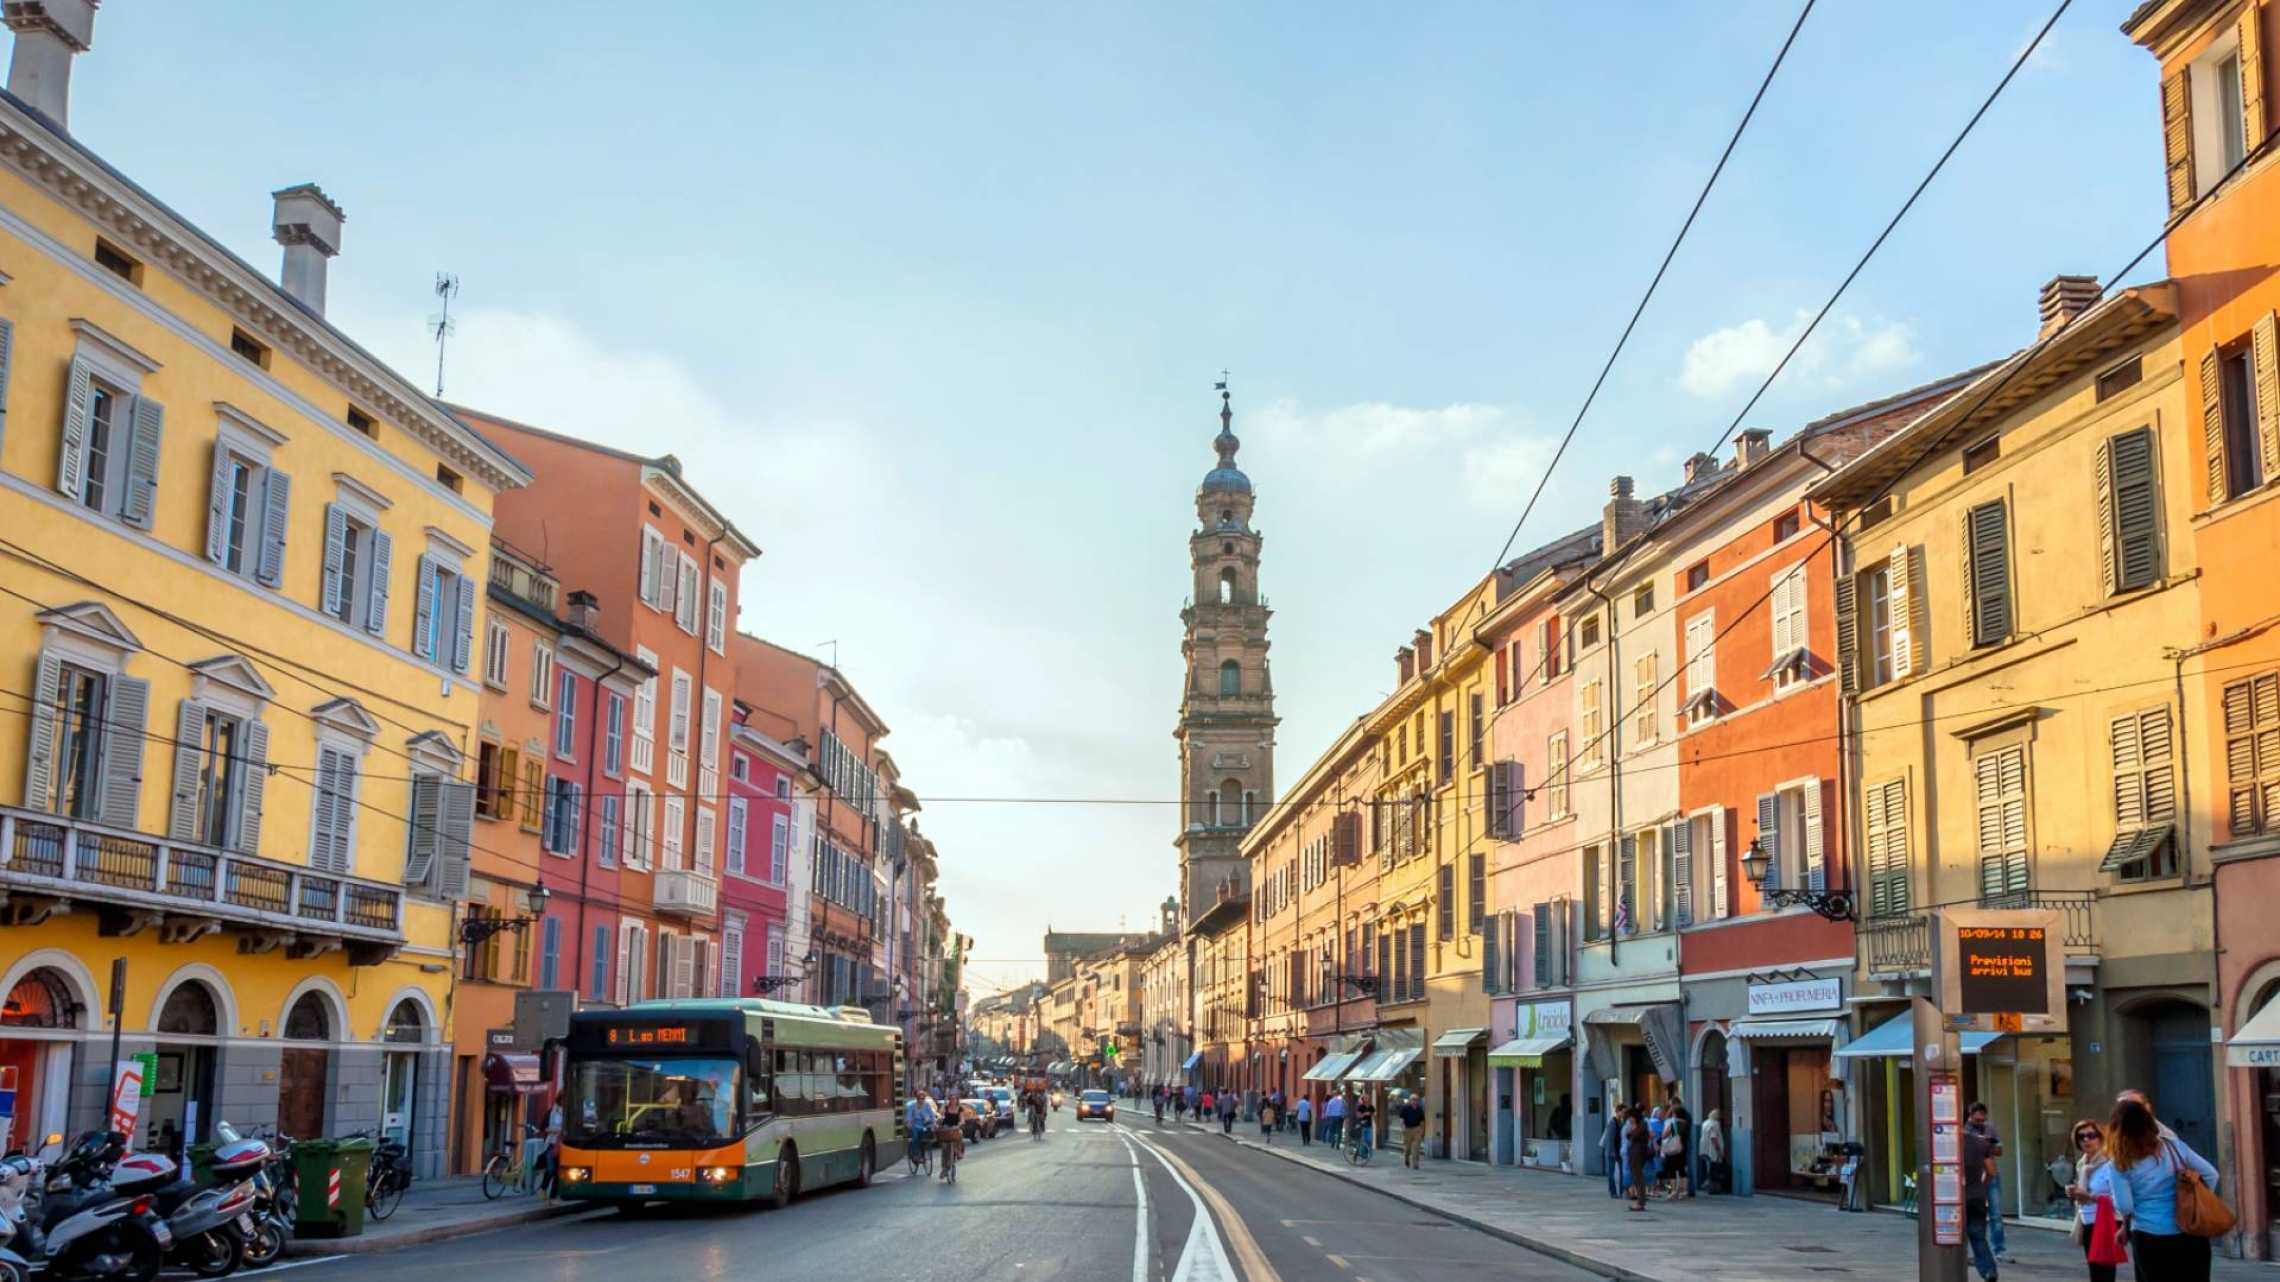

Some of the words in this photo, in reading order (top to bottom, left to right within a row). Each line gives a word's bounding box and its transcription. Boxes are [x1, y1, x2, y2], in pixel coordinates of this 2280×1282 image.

[1970, 954, 2032, 966] Previsioni
[1970, 966, 2008, 976] arrivi
[2013, 966, 2032, 976] bus
